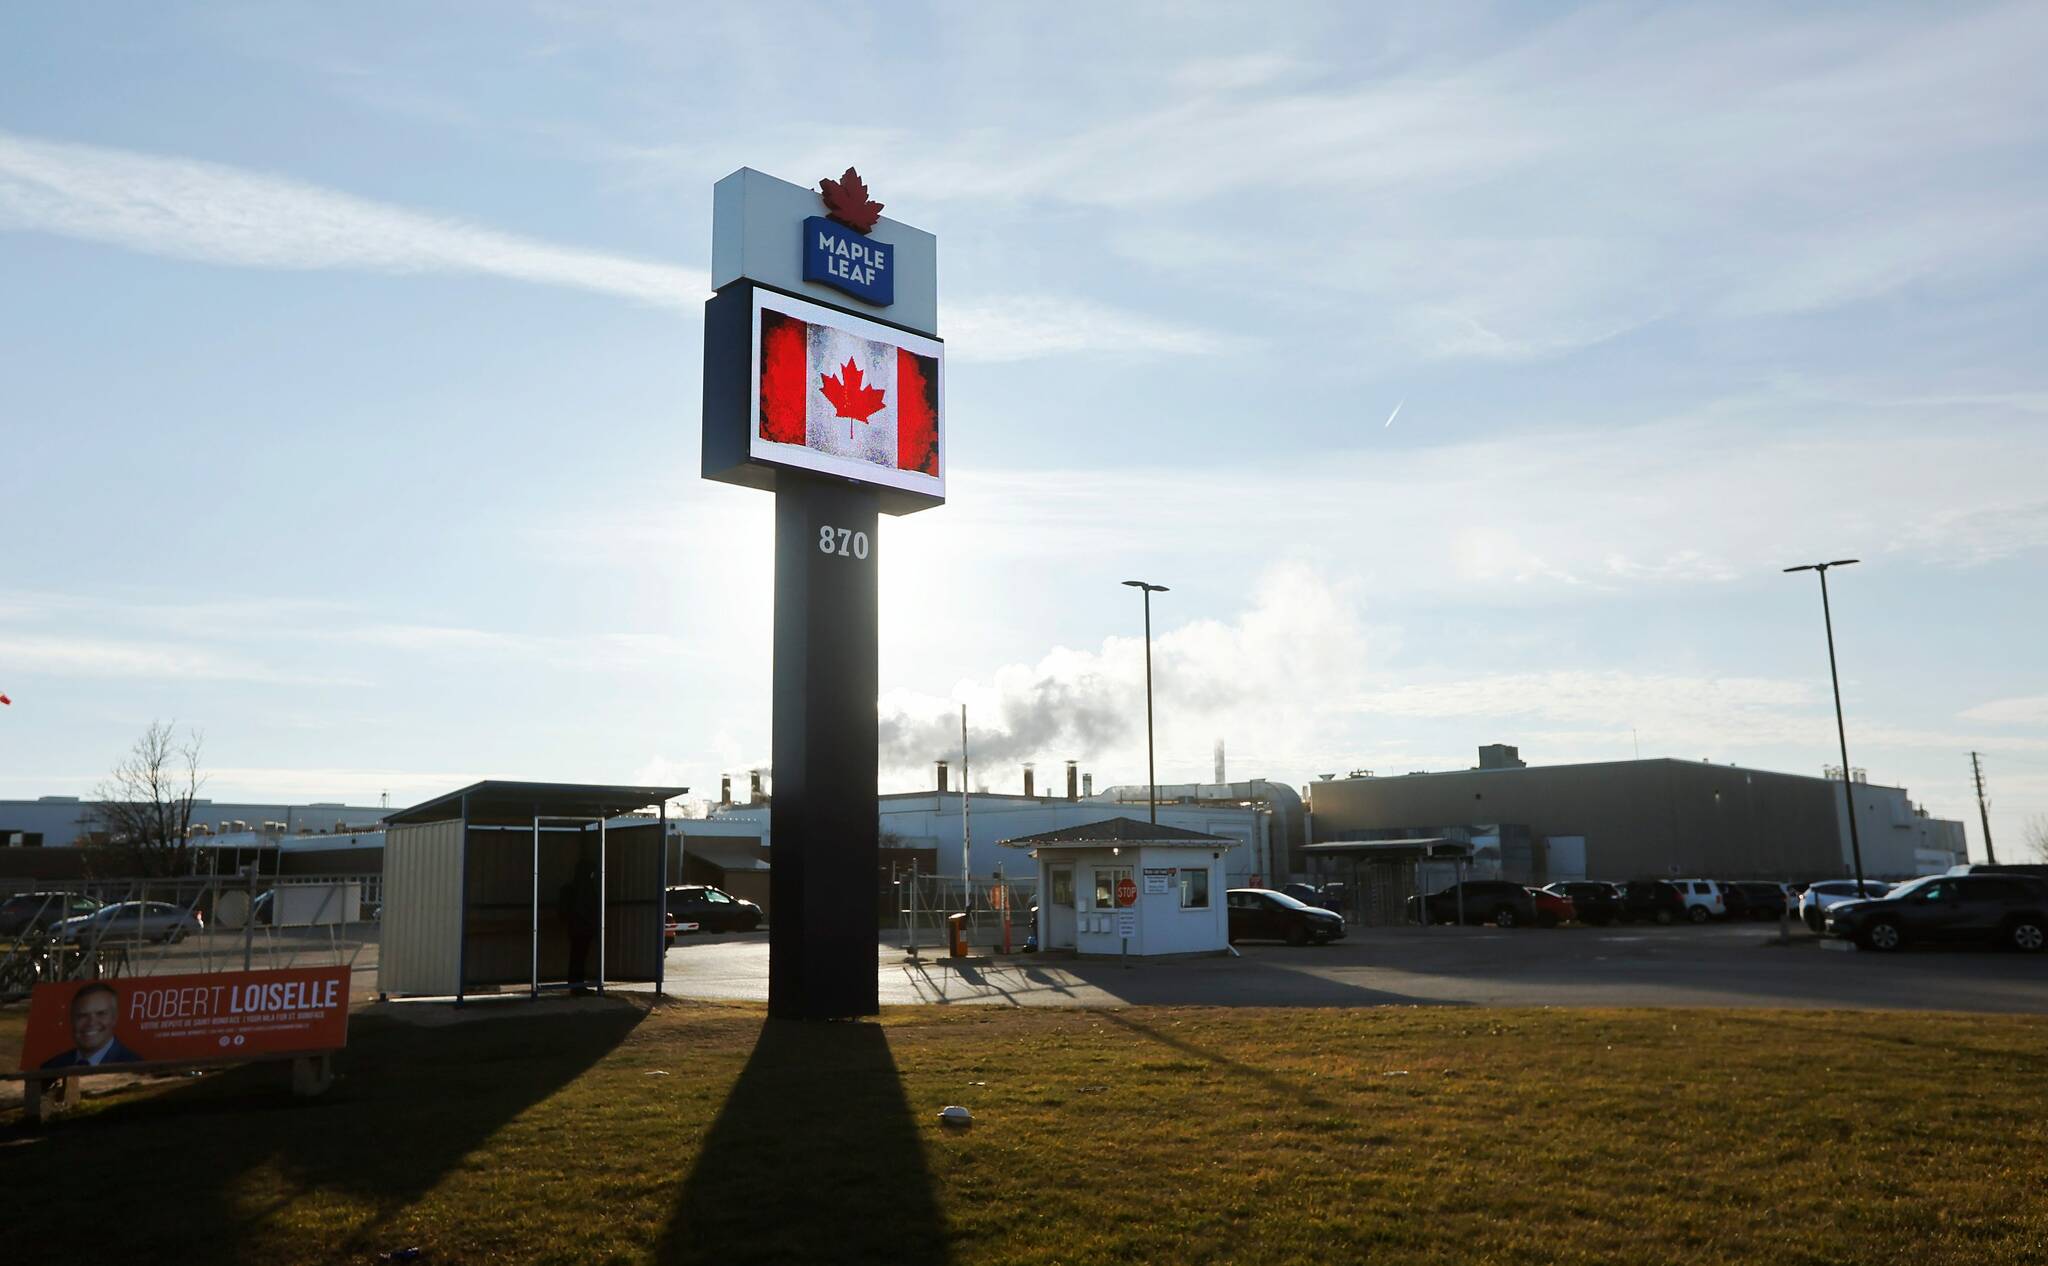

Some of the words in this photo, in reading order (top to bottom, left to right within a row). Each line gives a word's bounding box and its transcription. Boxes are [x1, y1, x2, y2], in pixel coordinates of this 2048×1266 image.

[819, 231, 884, 270] MAPLE
[828, 255, 876, 286] LEAF
[819, 525, 869, 560] 870
[1117, 886, 1136, 898] STOP
[130, 985, 225, 1020] ROBERT
[230, 979, 340, 1014] LOISELLE
